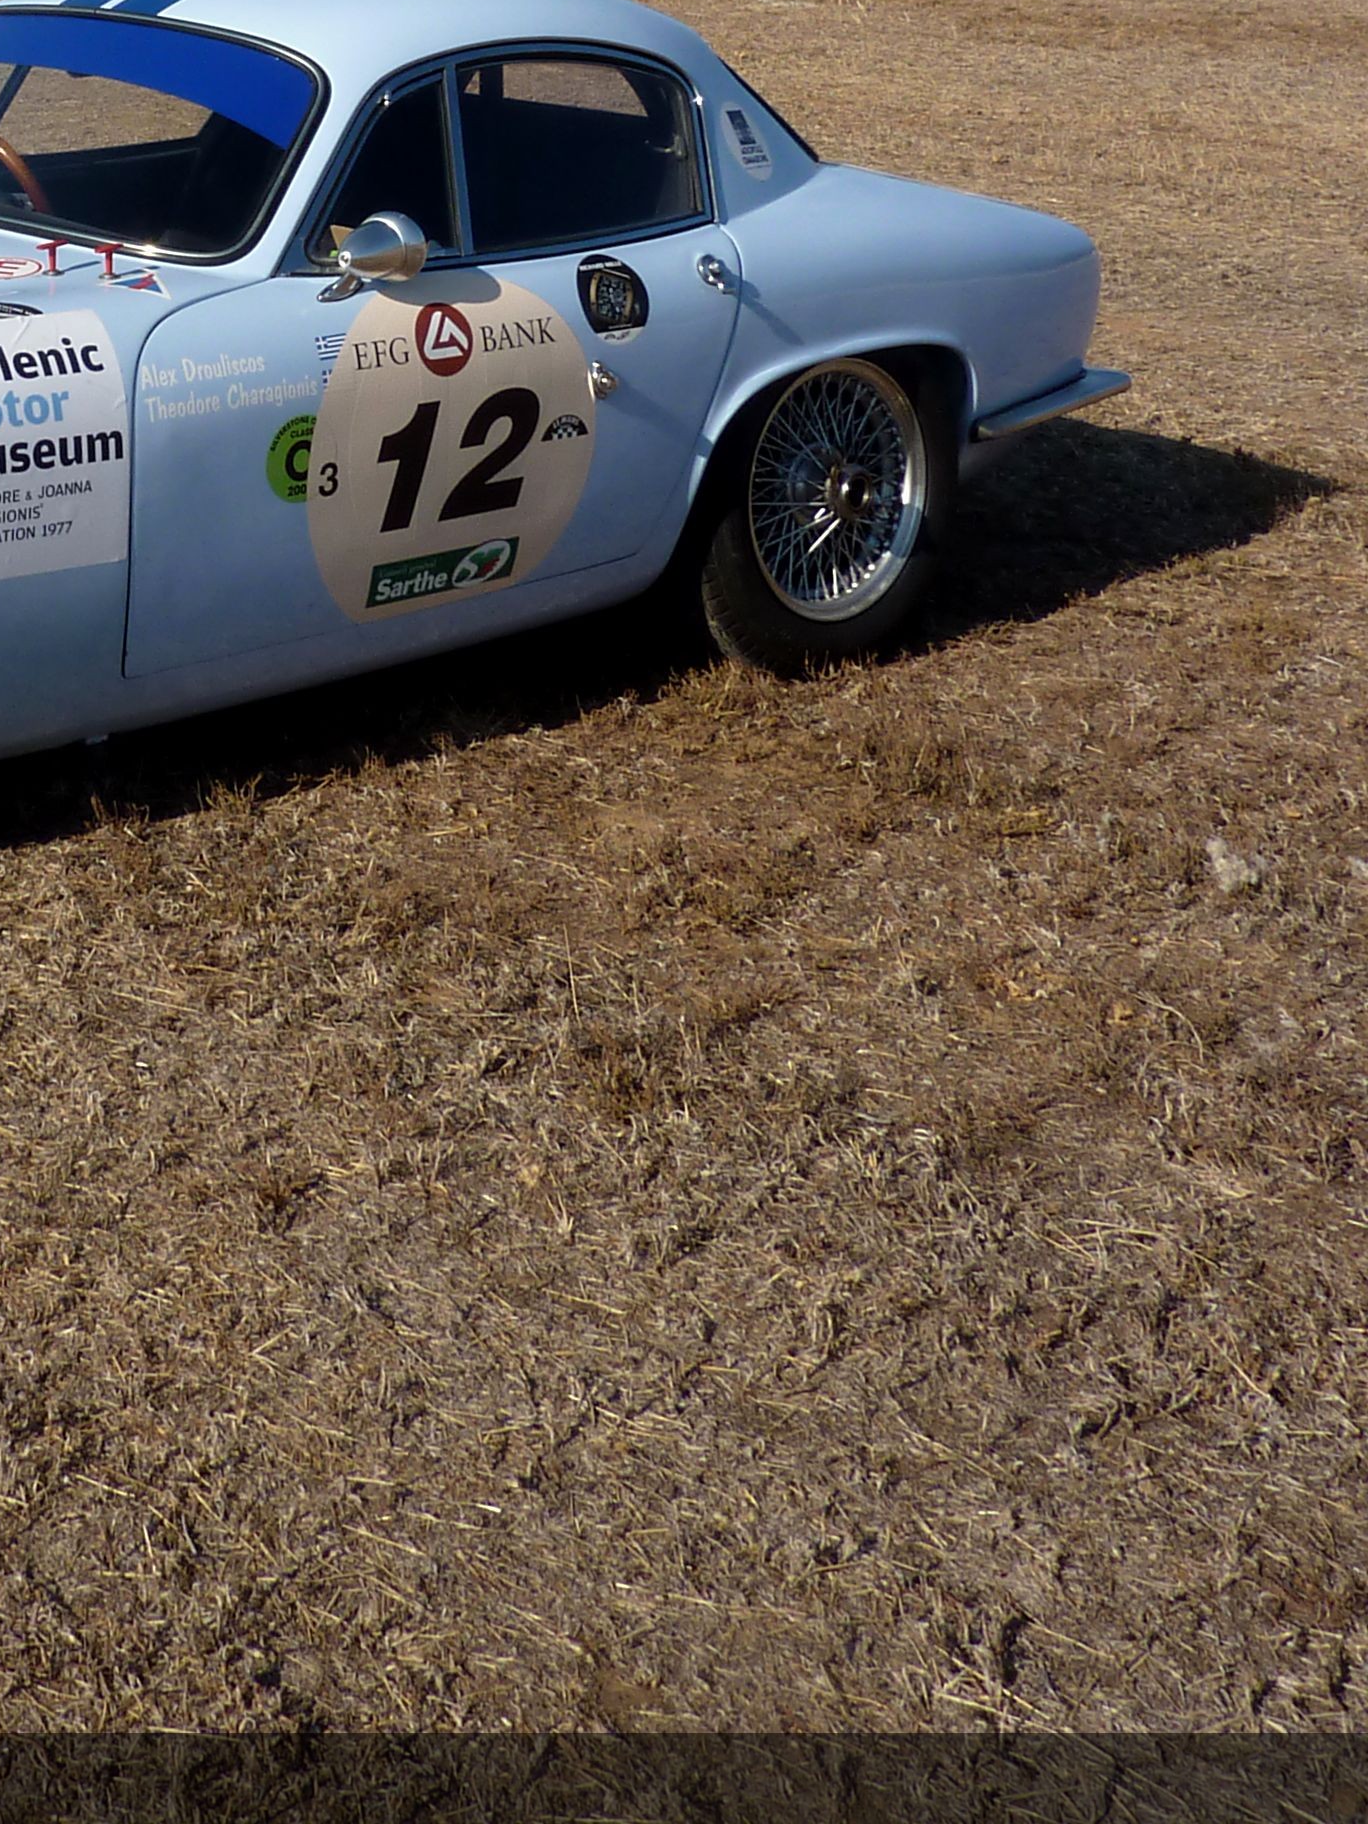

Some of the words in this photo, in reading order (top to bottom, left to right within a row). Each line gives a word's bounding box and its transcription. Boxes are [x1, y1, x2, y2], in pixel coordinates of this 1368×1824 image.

[353, 337, 410, 371] EFG
[480, 317, 556, 353] BANK
[141, 364, 179, 390] Alex
[182, 353, 265, 383] Drouliscos
[145, 391, 220, 423] Theodore
[377, 387, 540, 533] 12
[25, 491, 33, 501] &
[38, 480, 93, 499] JOANNA
[318, 462, 338, 498] 3
[42, 521, 73, 537] 1977
[375, 570, 448, 601] Sarthe
